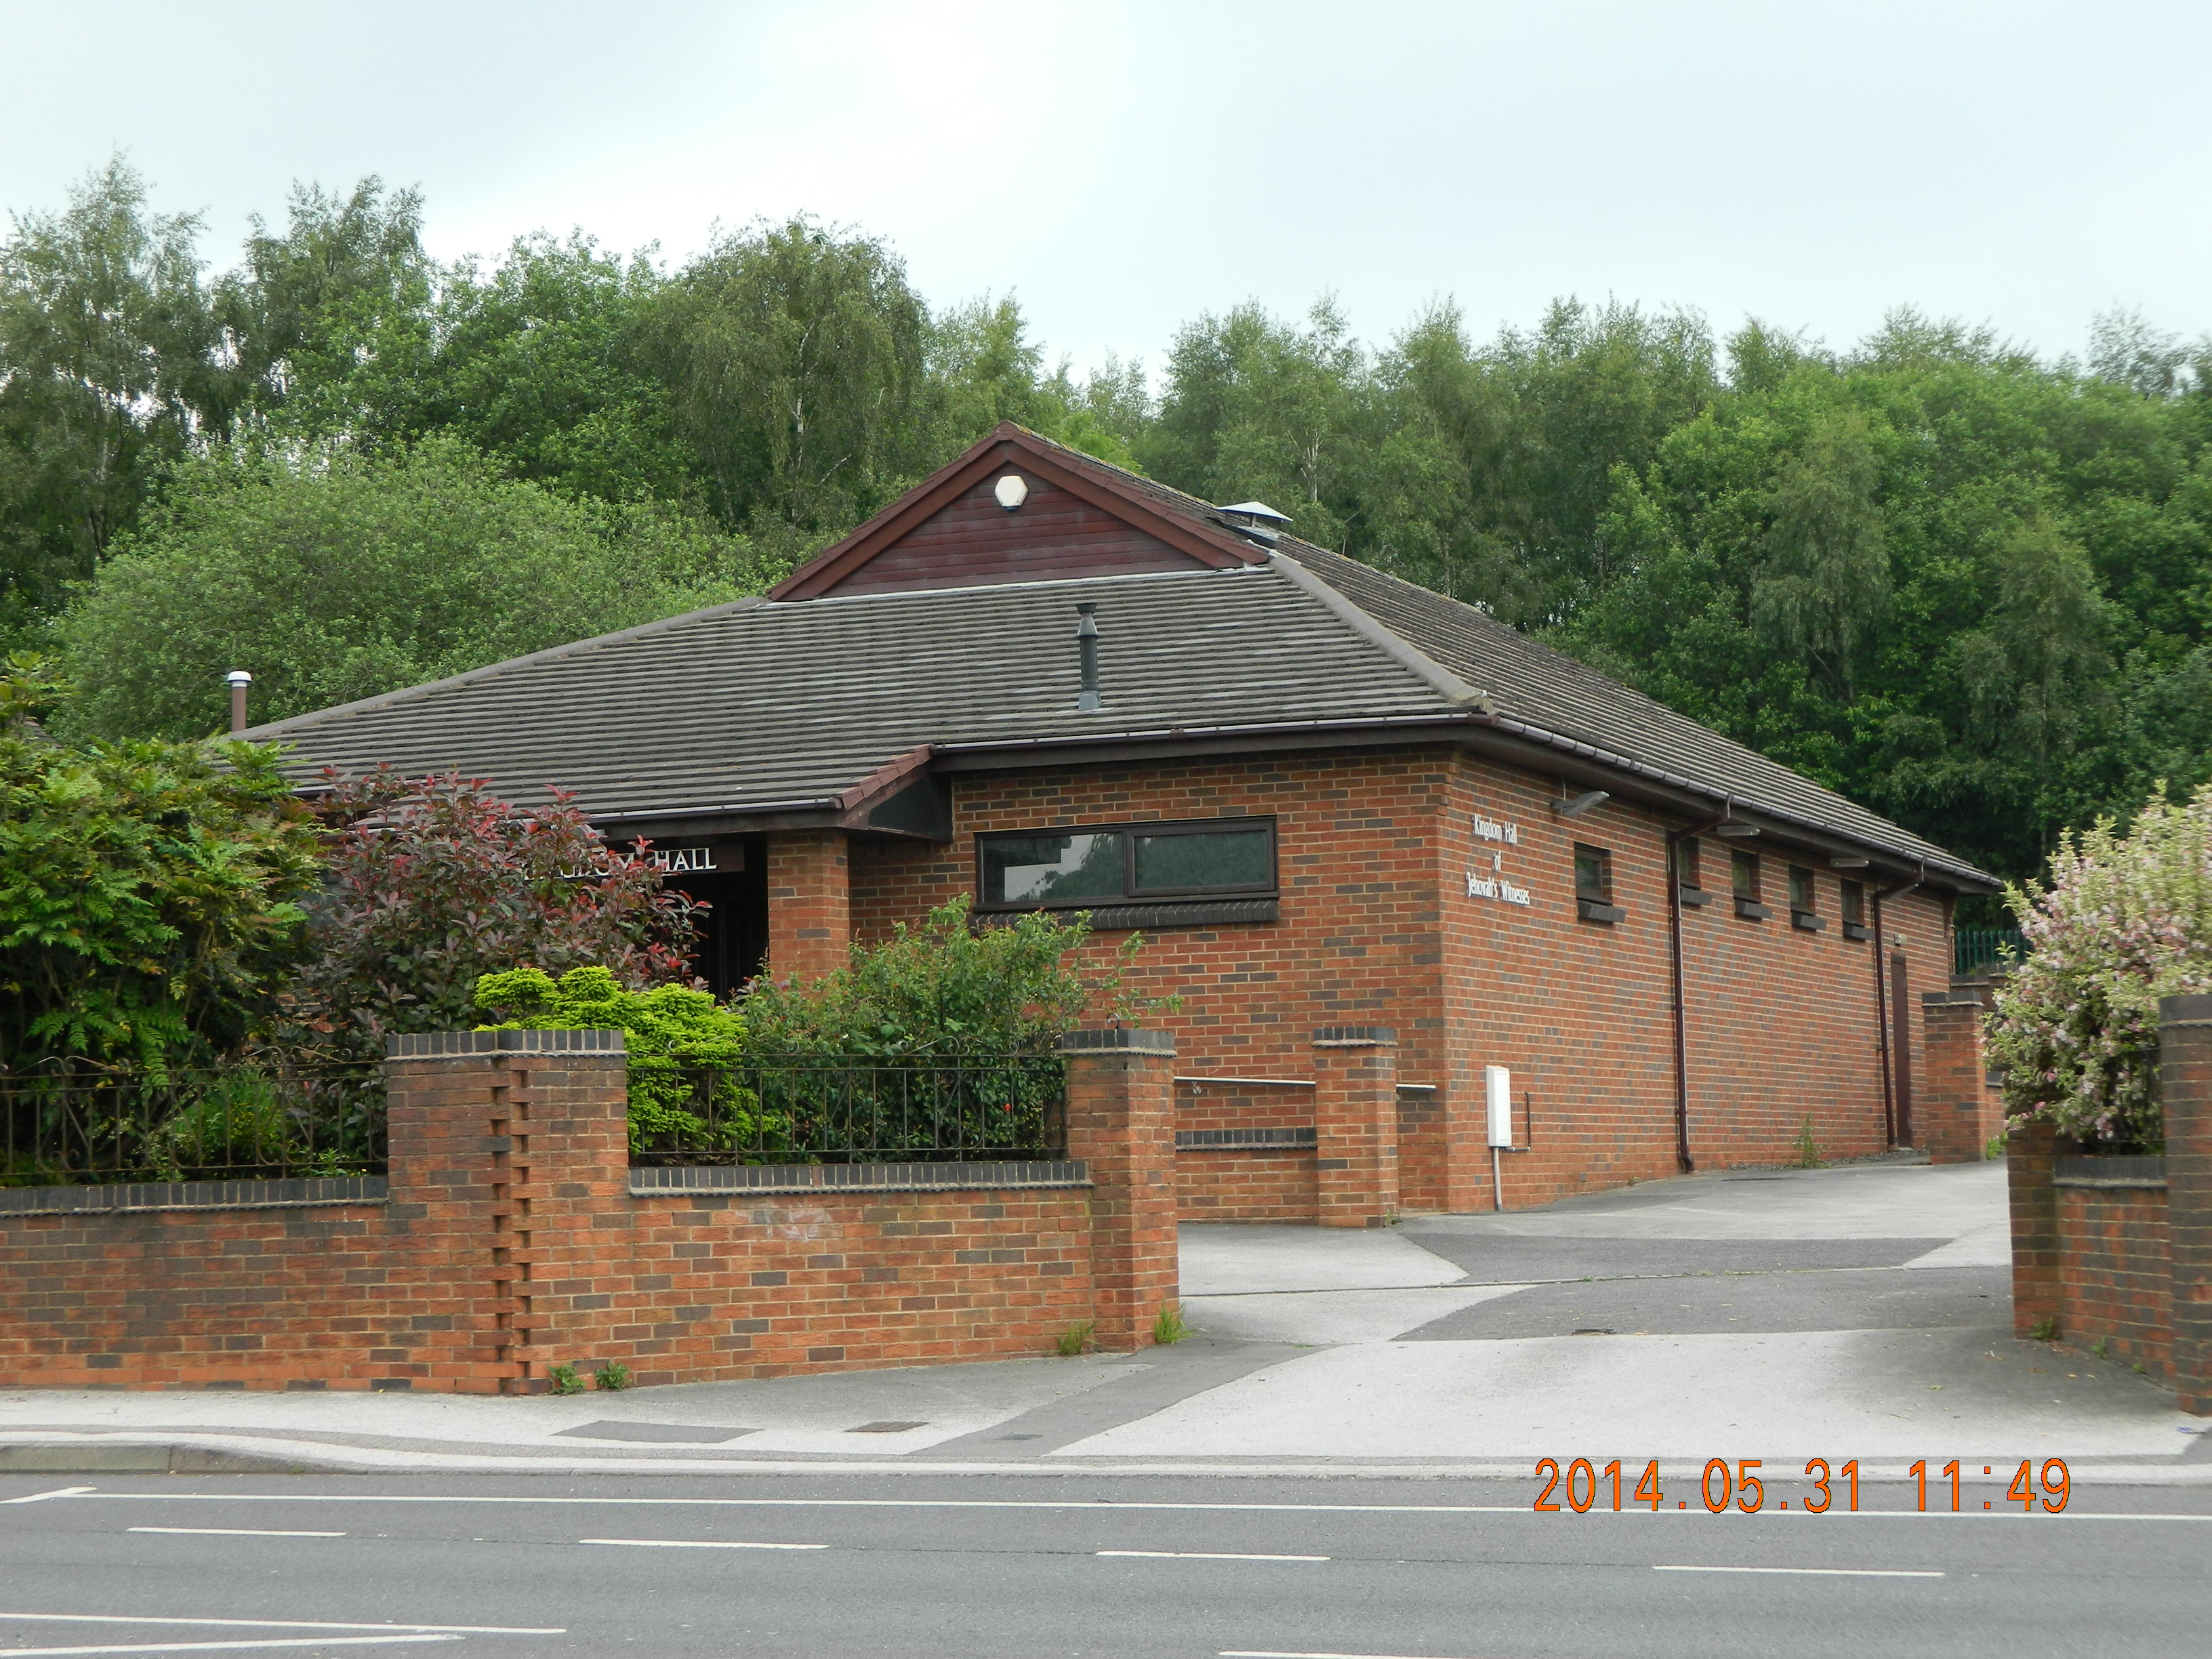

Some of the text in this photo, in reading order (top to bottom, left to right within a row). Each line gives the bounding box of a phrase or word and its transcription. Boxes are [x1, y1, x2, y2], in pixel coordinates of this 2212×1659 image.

[1473, 813, 1518, 844] Kingdom Hall
[655, 848, 717, 872] HALL
[1494, 850, 1502, 871] of
[1467, 872, 1531, 905] Jehovah's Witnesses
